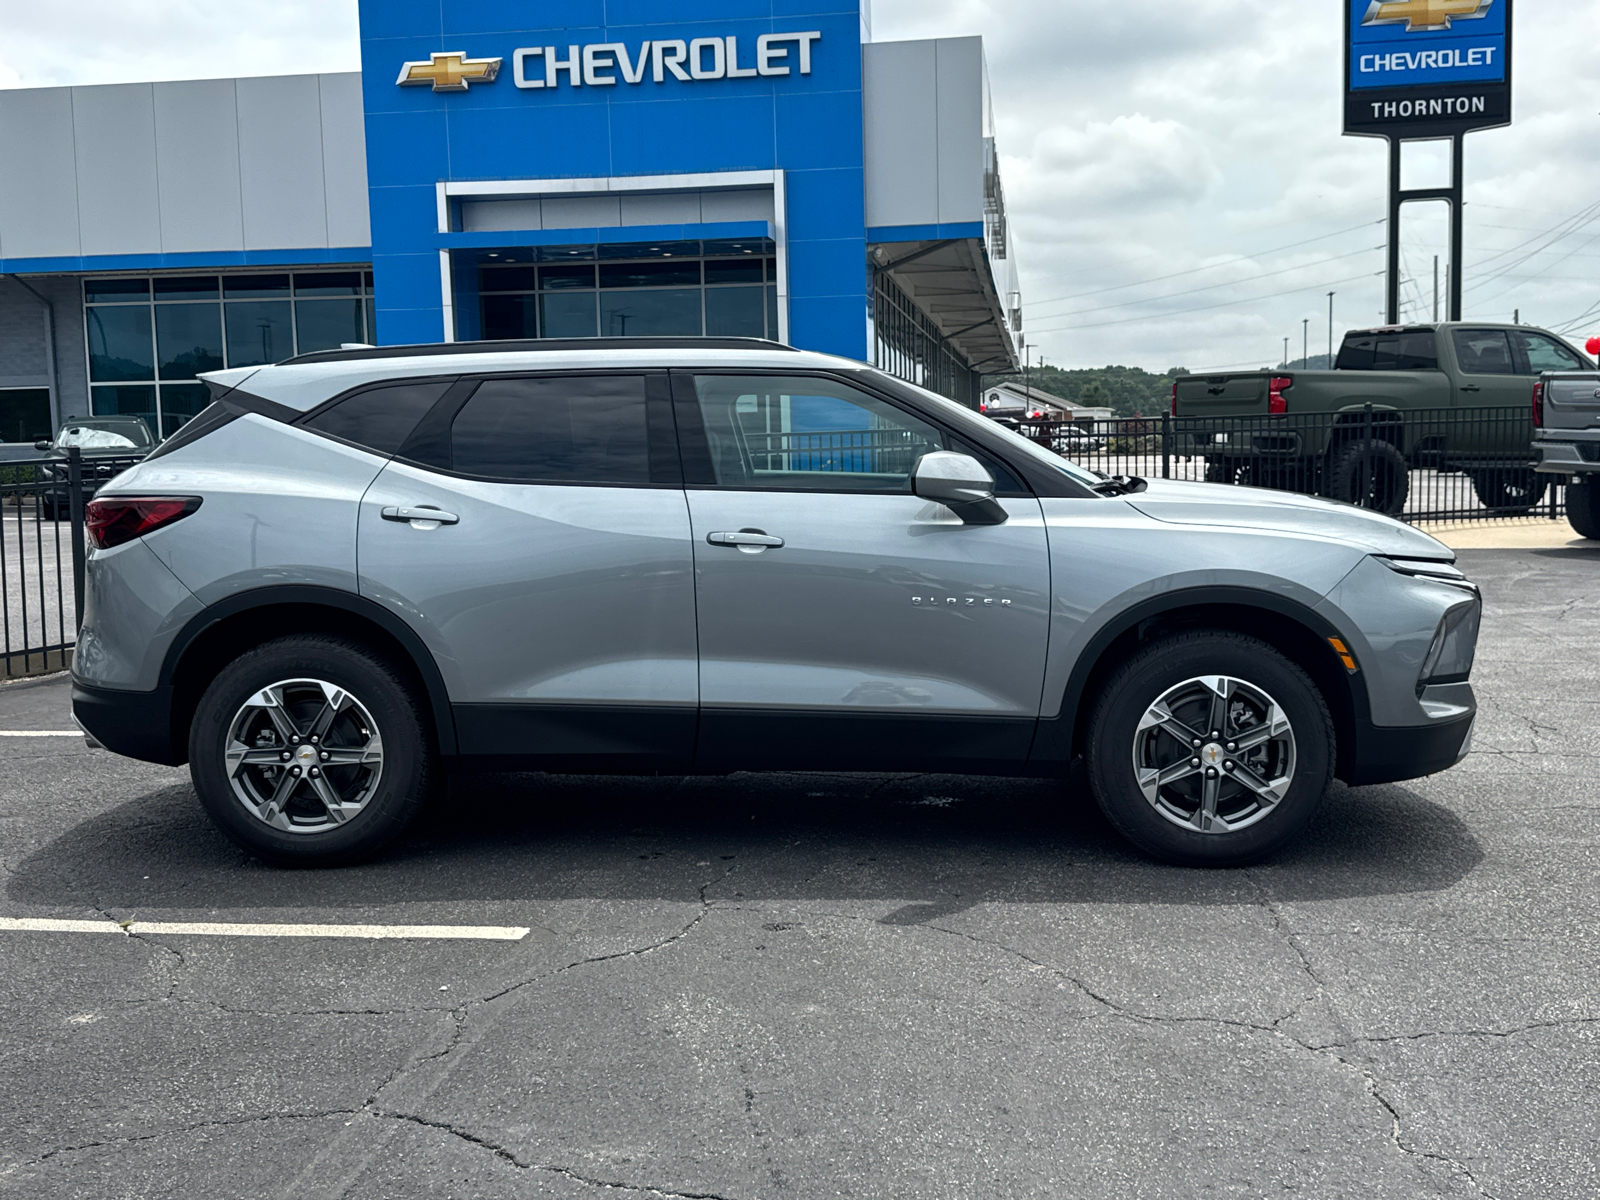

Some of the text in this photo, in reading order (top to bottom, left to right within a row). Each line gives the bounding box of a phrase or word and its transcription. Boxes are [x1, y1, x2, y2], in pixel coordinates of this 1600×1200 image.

[512, 31, 821, 89] CHEVROLET
[1360, 47, 1496, 73] CHEVROLET
[1371, 96, 1485, 119] THORNTON
[911, 596, 1012, 608] BLAZER
